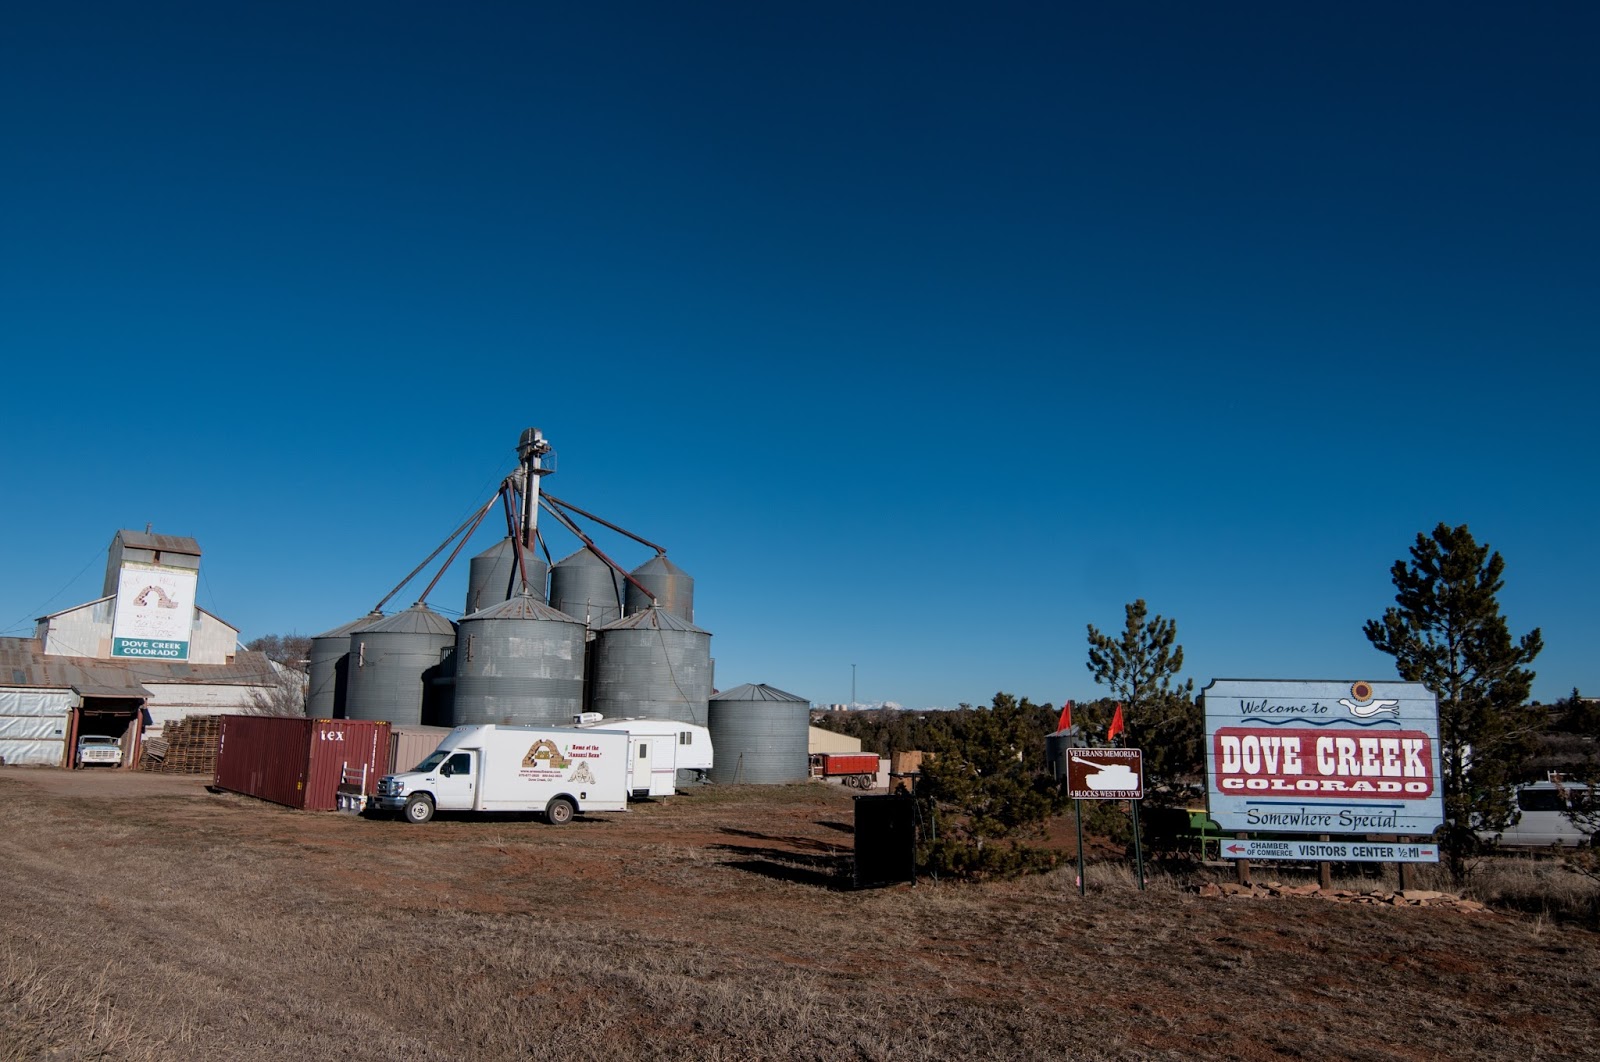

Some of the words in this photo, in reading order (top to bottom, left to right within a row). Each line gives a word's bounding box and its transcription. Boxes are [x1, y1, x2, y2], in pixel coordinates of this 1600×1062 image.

[121, 640, 149, 648] DOVE
[151, 642, 181, 650] CREEK
[123, 648, 178, 657] COLORADO
[1240, 699, 1309, 714] Welcome
[1311, 702, 1328, 714] to
[1104, 750, 1139, 758] MEMORIAL
[1221, 735, 1302, 775] DOVE
[1316, 736, 1426, 777] CREEK
[1222, 778, 1428, 793] COLORADO
[1247, 807, 1331, 826] Somewhere
[1250, 842, 1289, 850] CHAMBER
[1299, 845, 1347, 857] VISITORS
[1352, 846, 1394, 858] CENTER
[1408, 848, 1420, 858] MI
[1257, 849, 1293, 857] COMMERCE
